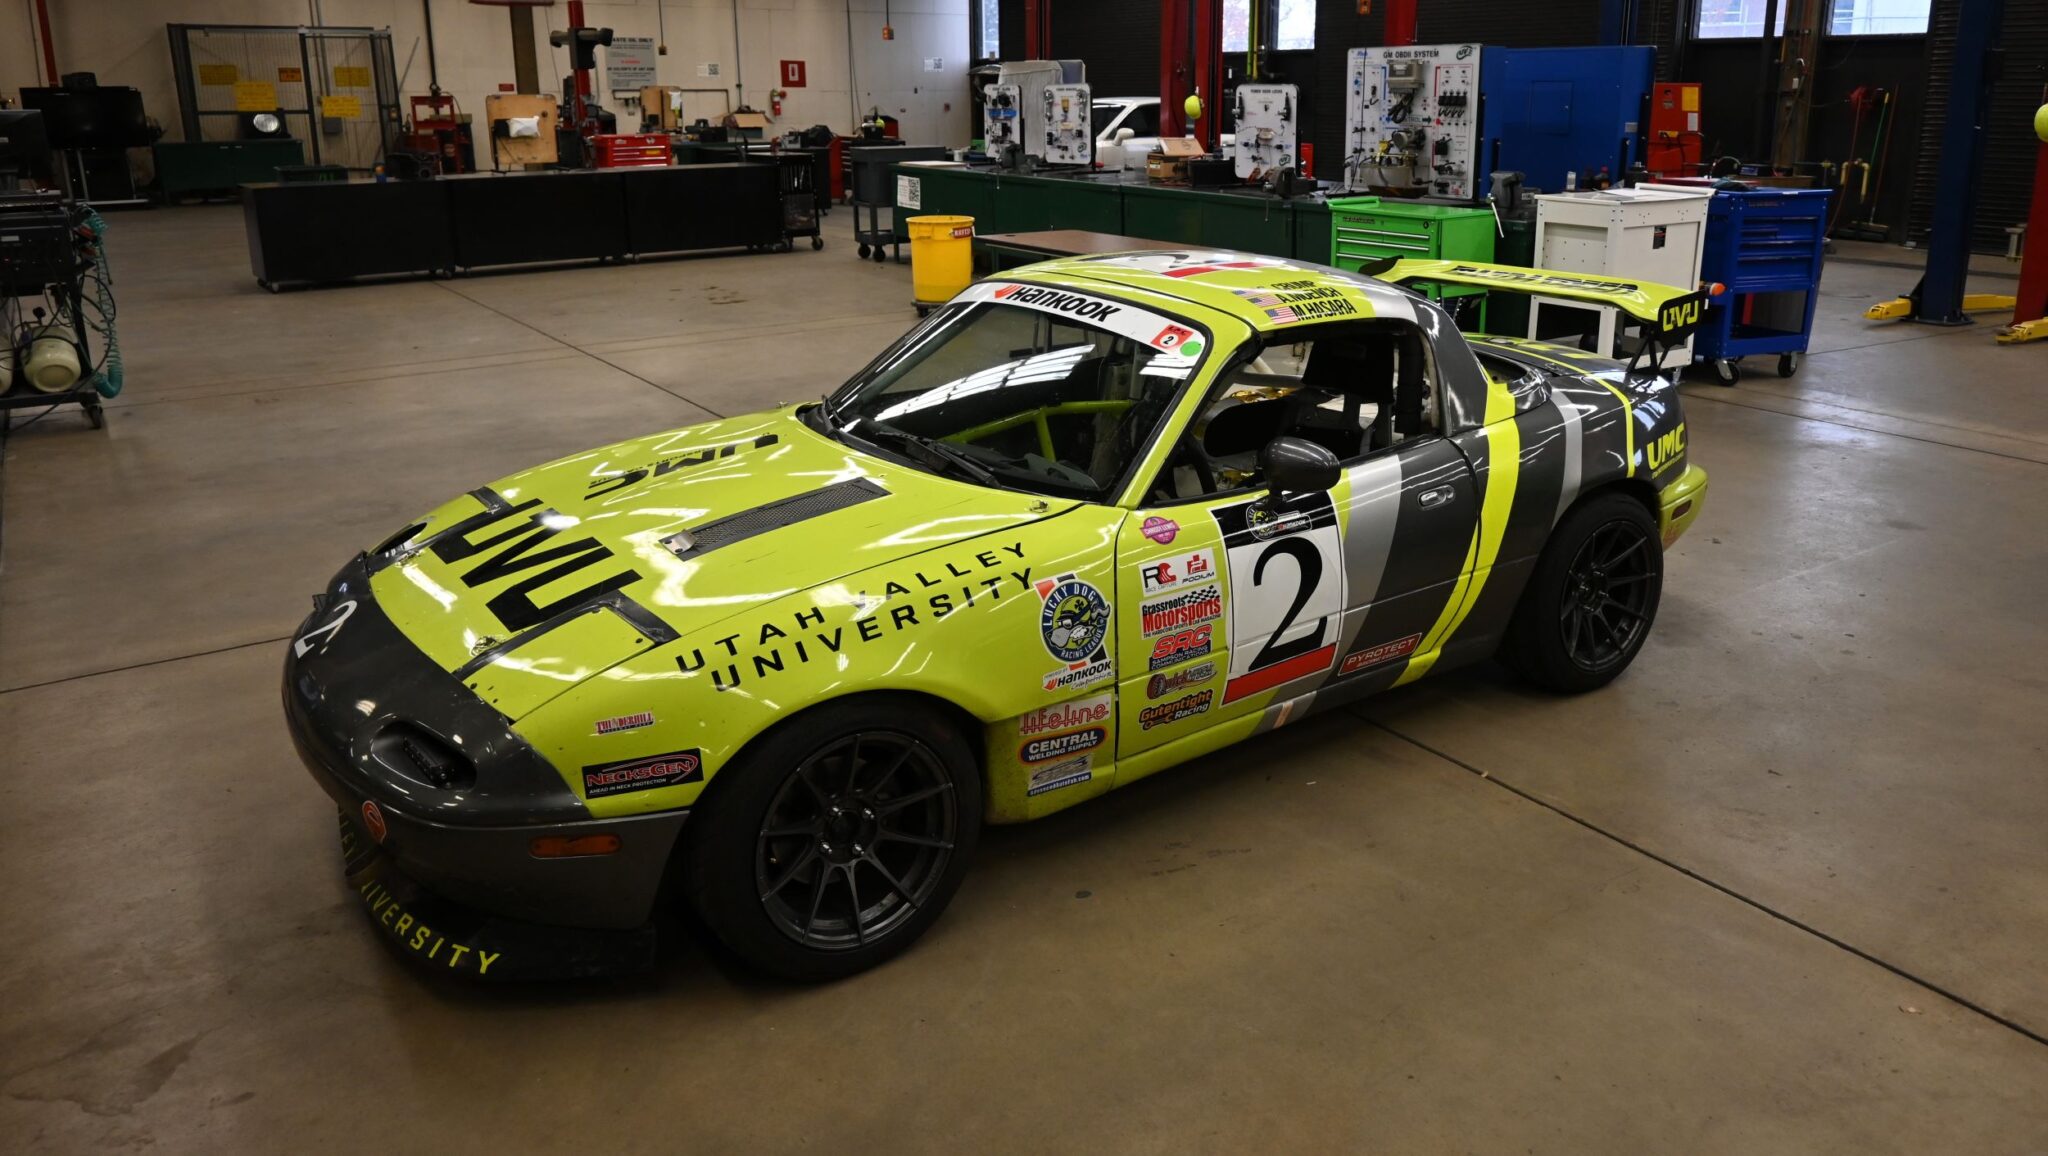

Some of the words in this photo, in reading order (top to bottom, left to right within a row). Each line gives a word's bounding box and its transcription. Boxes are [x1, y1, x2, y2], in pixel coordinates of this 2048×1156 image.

[1414, 49, 1439, 58] SYSTEM
[1663, 300, 1699, 332] UVU
[1163, 335, 1174, 345] 2
[1647, 422, 1685, 470] UMC
[430, 498, 643, 633] UVU
[1182, 571, 1215, 584] PODIUM
[1043, 585, 1068, 626] LUCKY
[1074, 583, 1097, 602] DOG
[1142, 597, 1186, 616] Grassroots
[1143, 595, 1221, 634] Motorsports
[1248, 536, 1328, 672] 2
[675, 607, 825, 674] UTAH
[711, 568, 1033, 692] UNIVERSITY
[1060, 648, 1084, 659] RACING
[1086, 630, 1104, 653] LEAGUE
[1347, 638, 1415, 666] PYROTECT
[1174, 702, 1209, 720] Racing
[1028, 731, 1098, 754] CENTRAL
[1028, 746, 1066, 761] WELDING
[1067, 740, 1098, 752] SUPPLY
[589, 786, 609, 794] AHEAD
[632, 778, 667, 788] PROTECTION
